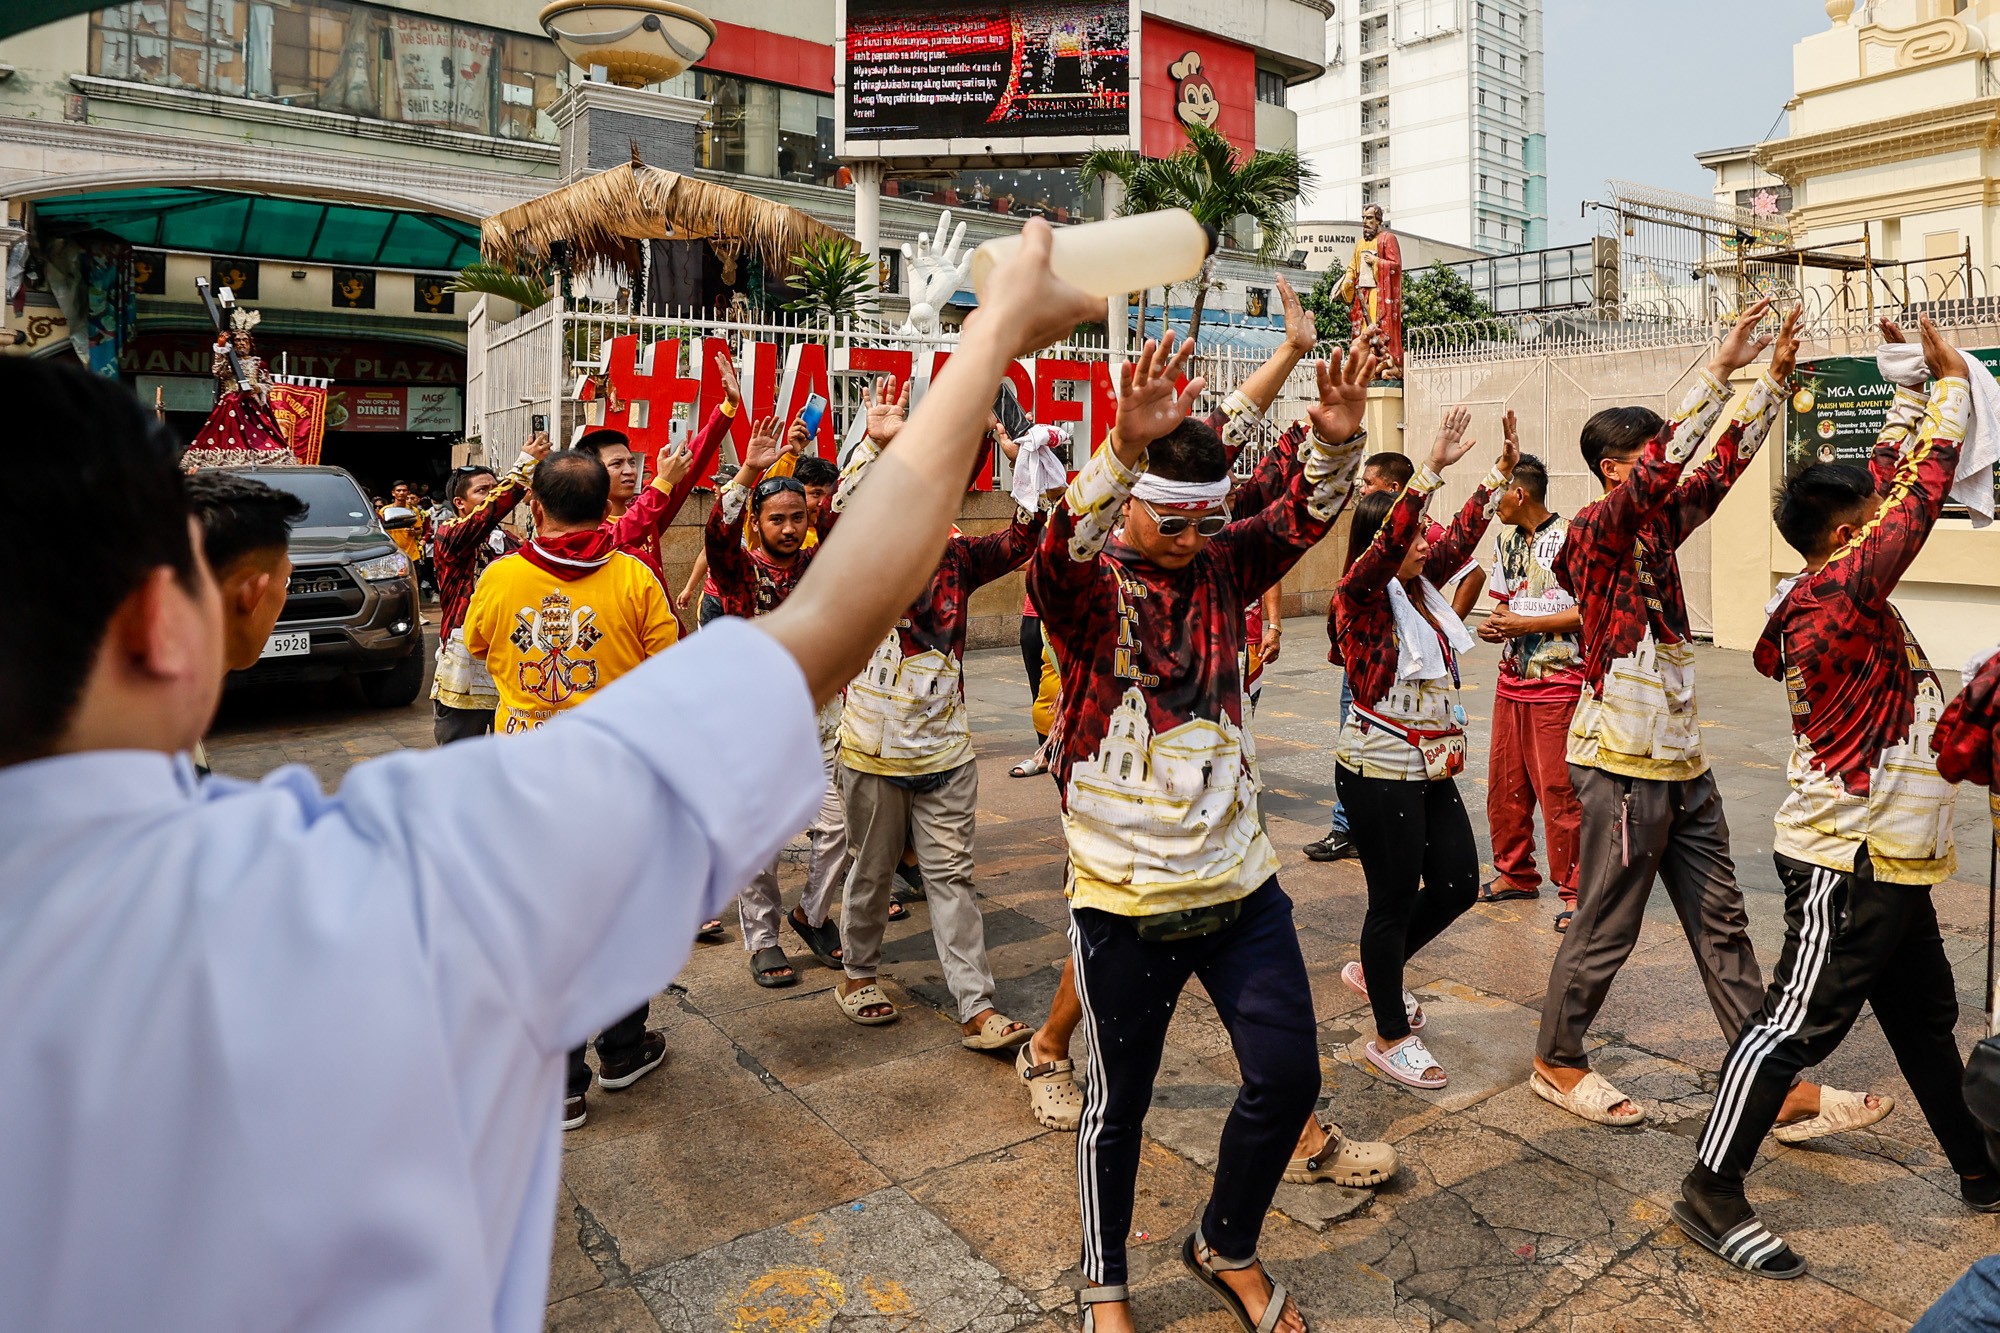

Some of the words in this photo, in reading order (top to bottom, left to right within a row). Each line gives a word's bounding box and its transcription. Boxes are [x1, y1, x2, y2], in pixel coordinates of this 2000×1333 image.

[416, 33, 434, 45] Sell
[407, 99, 429, 113] Stall
[1318, 234, 1356, 244] GUANZON
[1313, 245, 1335, 253] BLDG.
[119, 349, 210, 374] MANI
[270, 354, 341, 378] CITY
[354, 358, 457, 381] PLAZA
[269, 391, 283, 402] SA
[1826, 385, 1855, 398] MGA
[1858, 384, 1896, 396] GAWA
[356, 405, 400, 415] DINE-IN
[1817, 402, 1838, 410] PARISH
[1838, 401, 1855, 409] WIDE
[1856, 400, 1884, 408] ADVENT
[1834, 409, 1856, 417] Tuesday,
[274, 637, 308, 652] 5928
